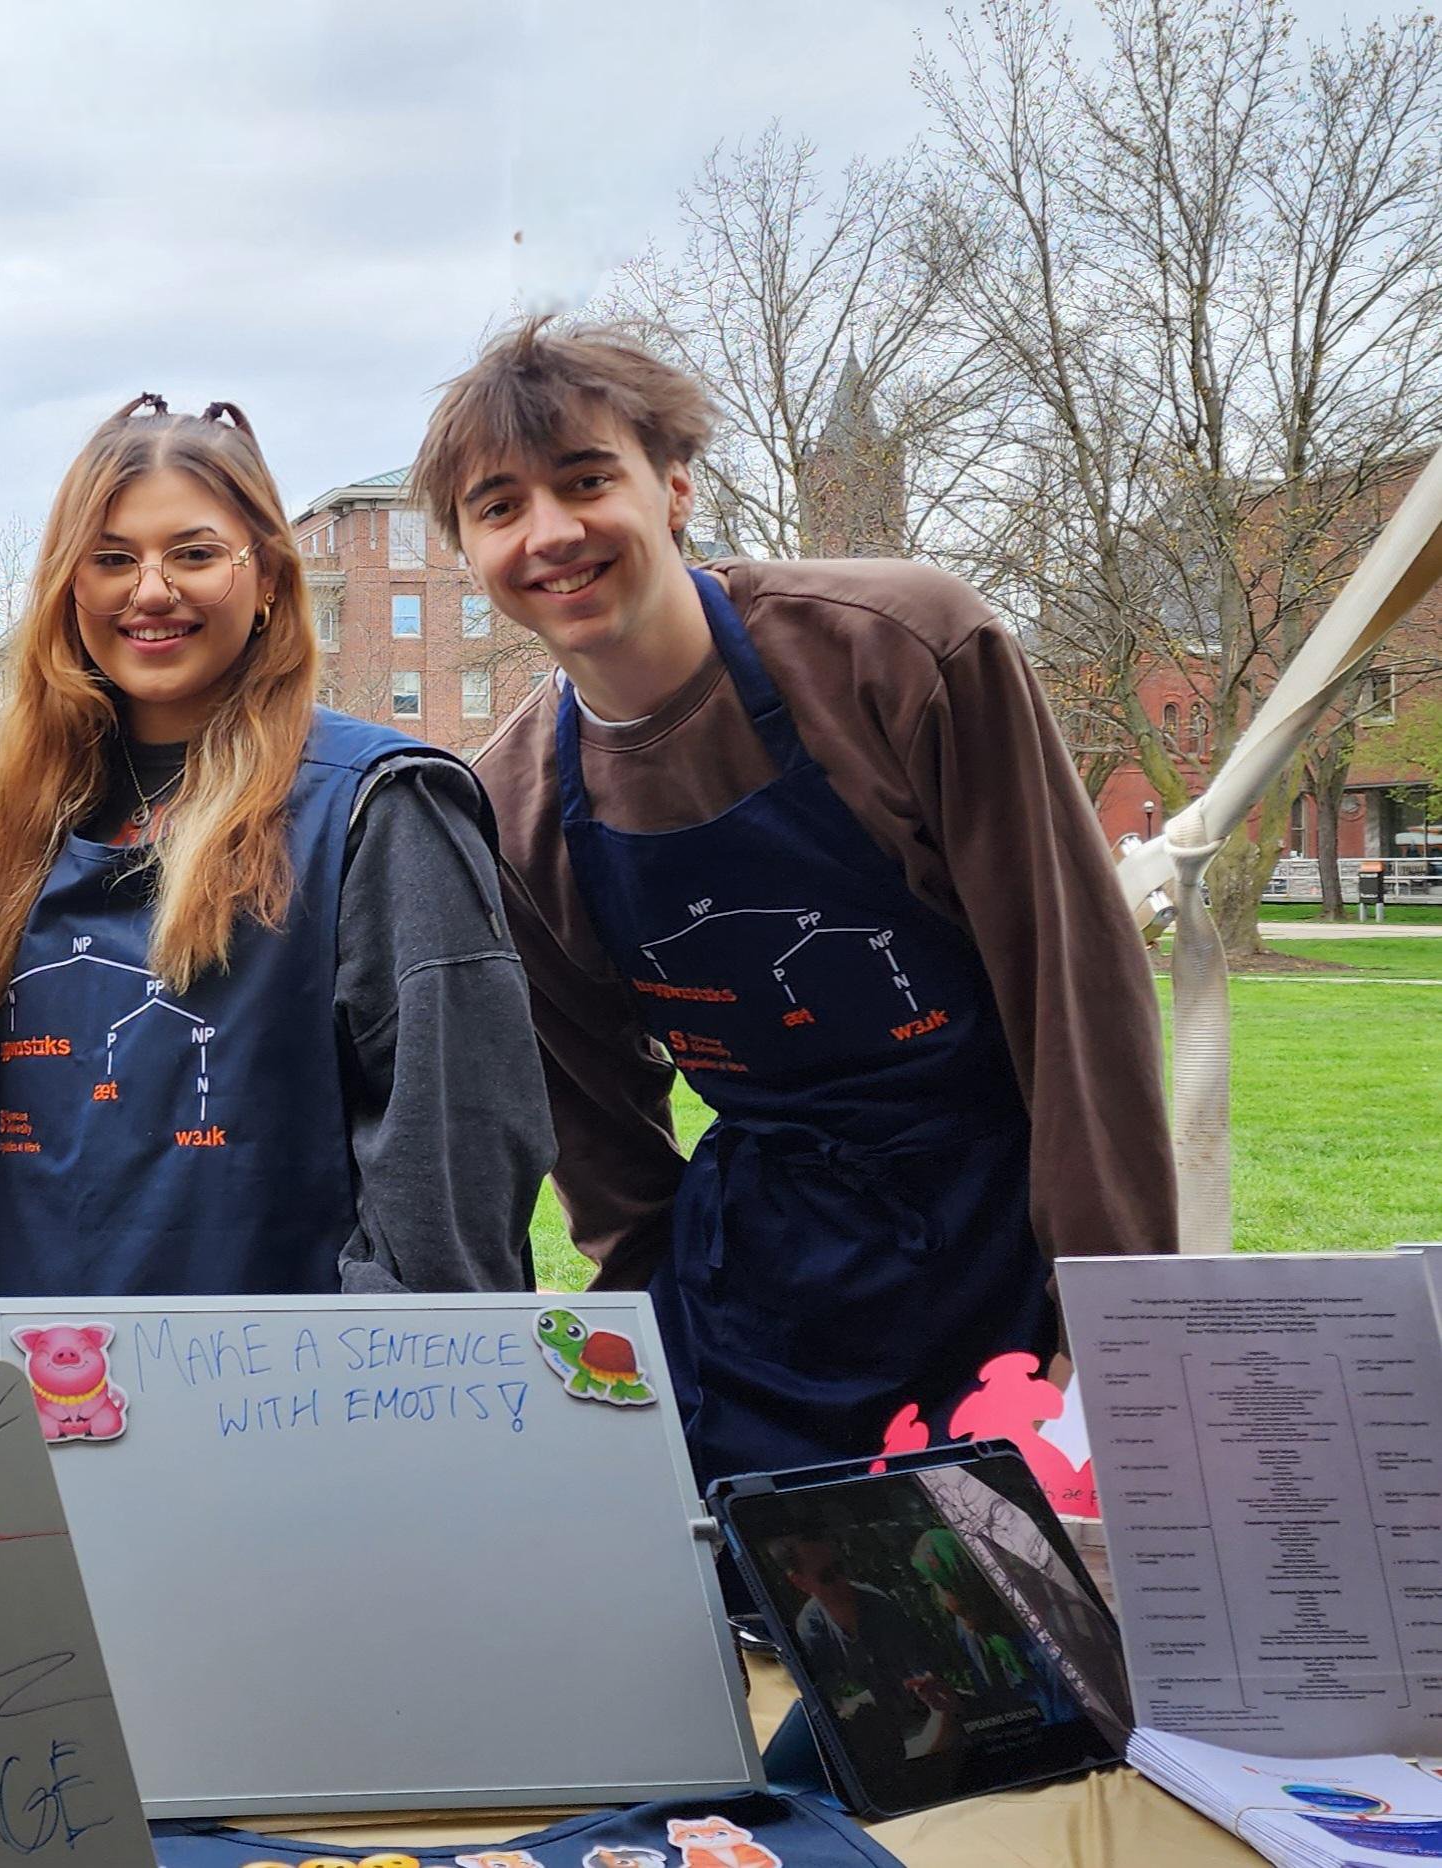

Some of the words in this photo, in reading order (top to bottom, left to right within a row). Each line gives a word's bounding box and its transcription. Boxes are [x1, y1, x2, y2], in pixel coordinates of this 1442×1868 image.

[688, 898, 713, 918] NP
[797, 911, 822, 930] PP
[72, 936, 93, 954] NP
[868, 930, 894, 950] NP
[772, 968, 787, 982] P
[892, 974, 910, 990] N
[146, 980, 165, 996] PP
[107, 1032, 117, 1048] P
[191, 1027, 216, 1044] NP
[668, 1030, 687, 1051] S
[197, 1077, 209, 1093] N
[134, 1318, 271, 1393] MAKE
[295, 1328, 321, 1372] A
[338, 1327, 525, 1371] SENTENCE
[219, 1389, 320, 1437] WITH
